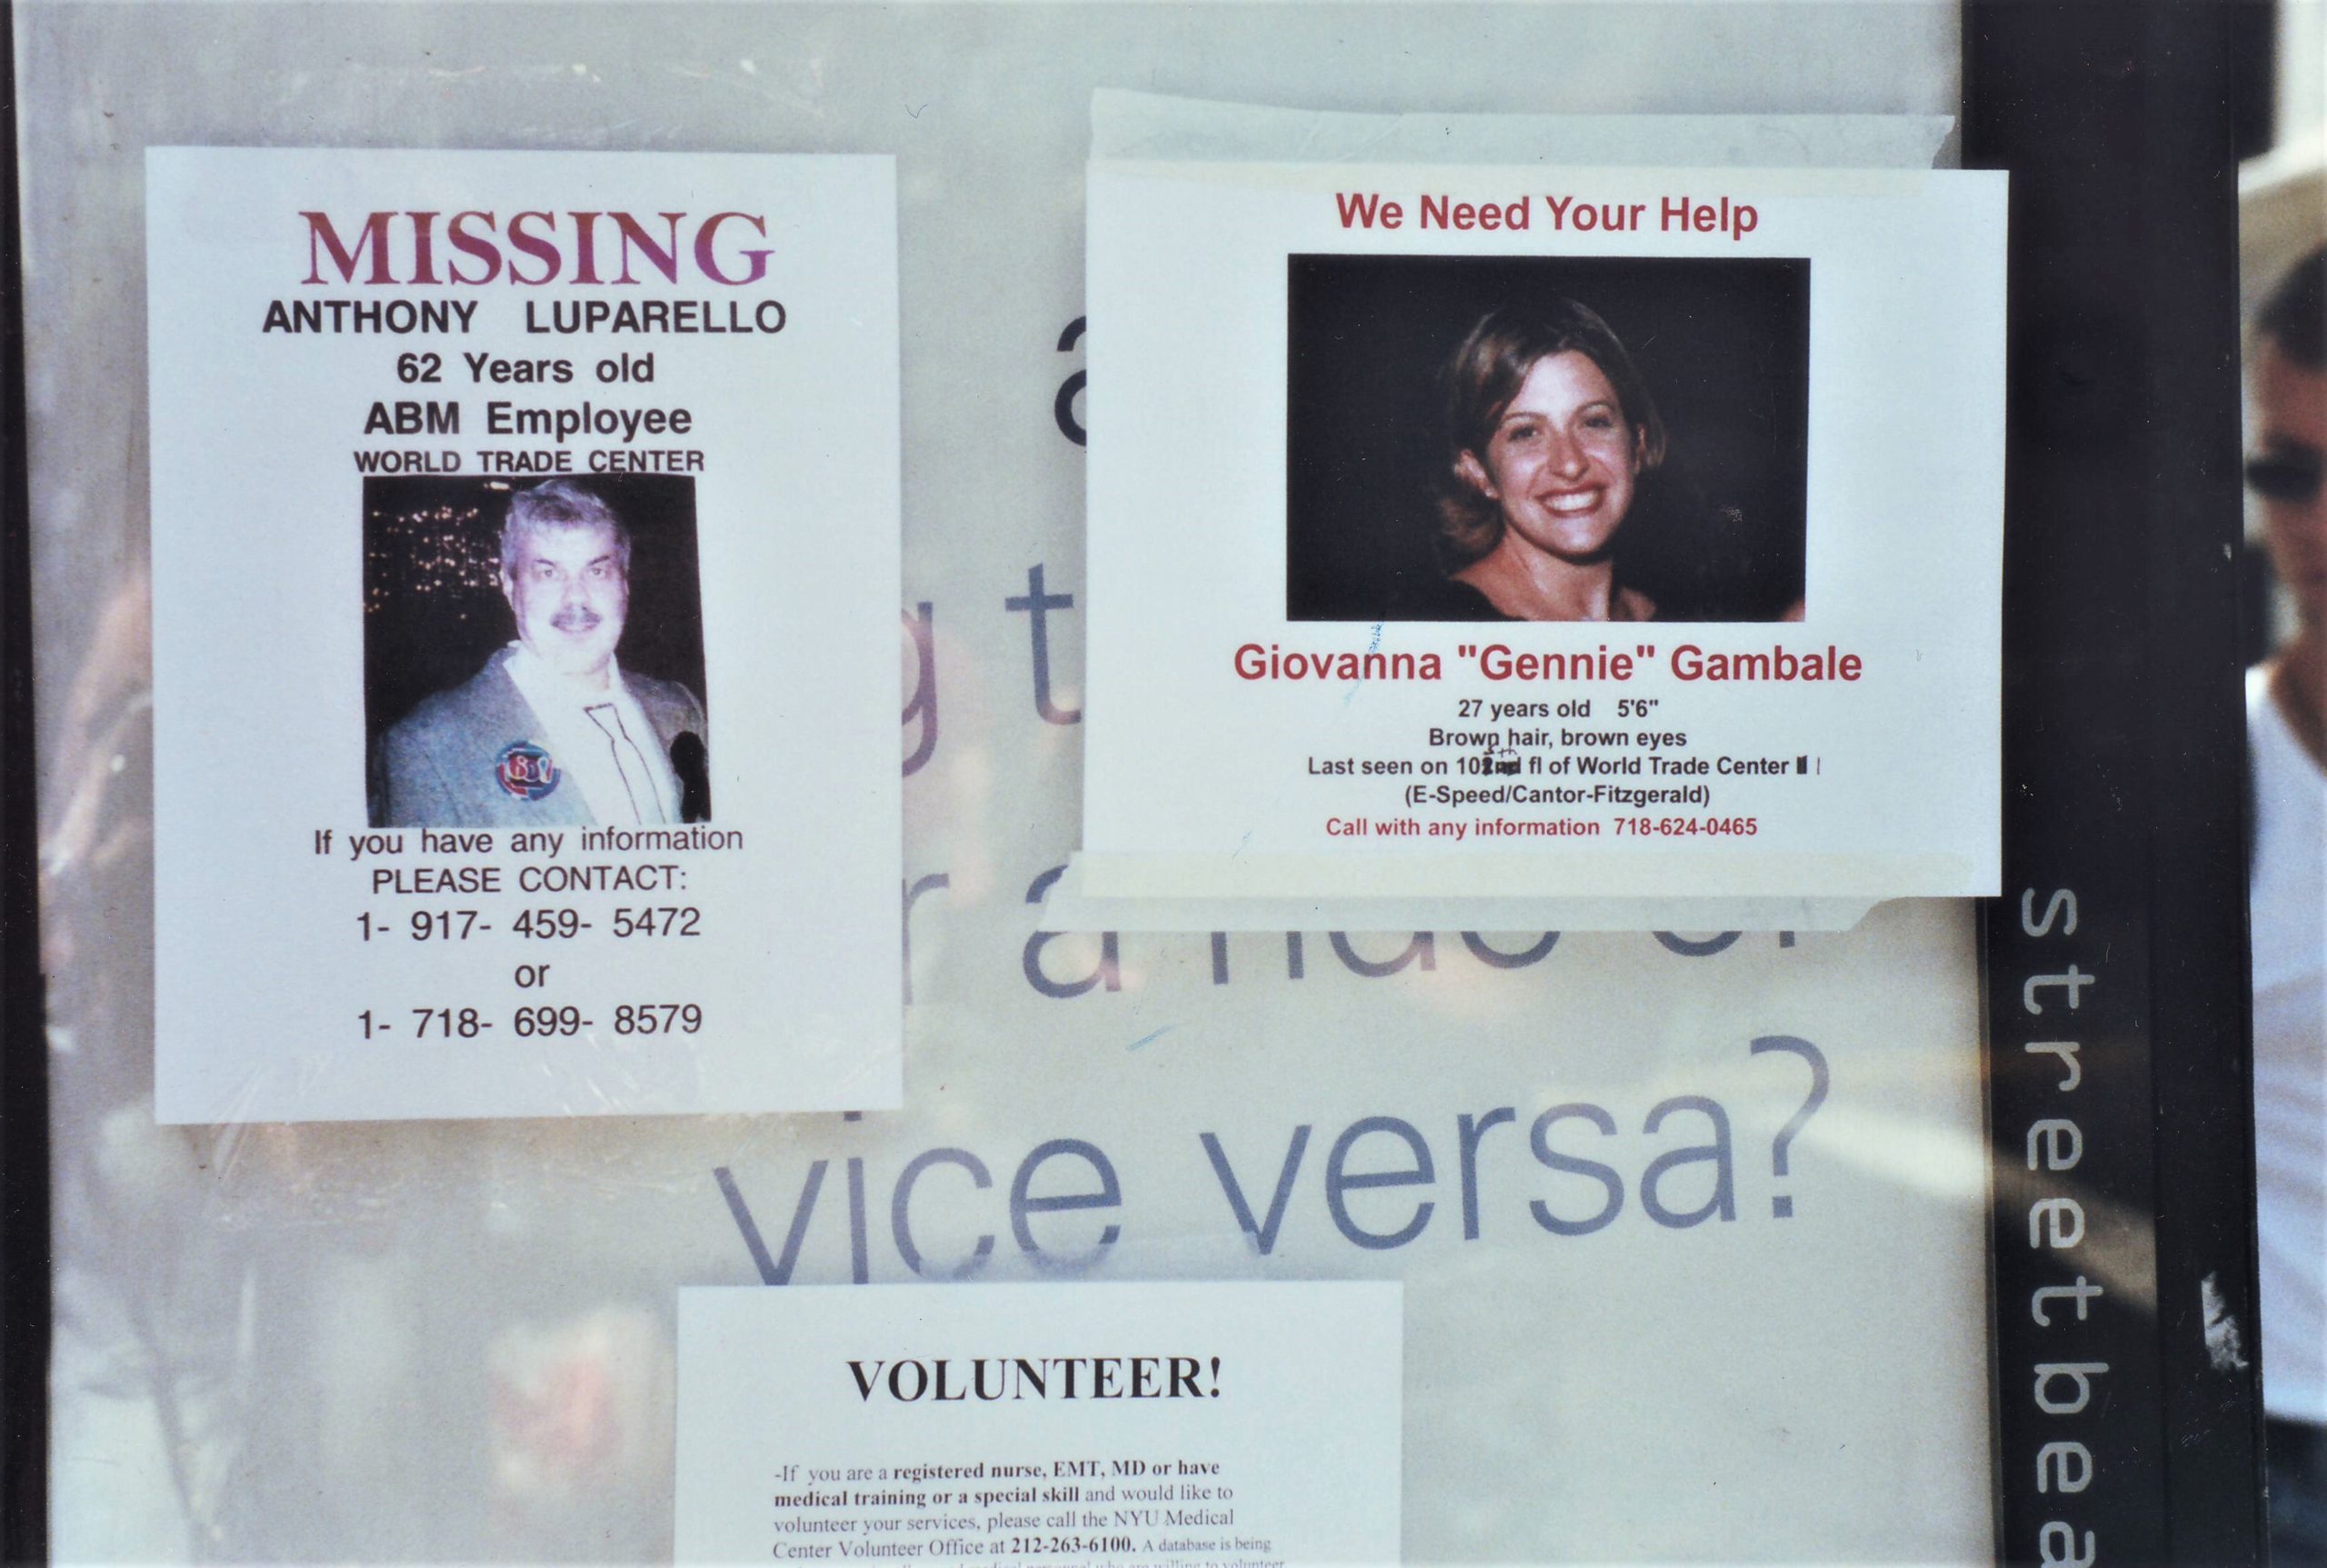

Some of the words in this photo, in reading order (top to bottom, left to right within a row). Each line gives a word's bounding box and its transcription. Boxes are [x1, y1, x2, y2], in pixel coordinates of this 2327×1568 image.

[1335, 192, 1403, 230] We
[1420, 194, 1530, 231] Need
[1545, 195, 1647, 232] Your
[1661, 196, 1759, 242] Help
[298, 211, 774, 286] MISSING
[262, 299, 478, 335] ANTHONY
[525, 299, 787, 335] LUPARELLO
[396, 352, 442, 384] 62
[463, 352, 574, 384] Years
[595, 352, 654, 384] old
[363, 401, 460, 435] ABM
[486, 401, 693, 444] Employee
[353, 450, 462, 476] WORLD
[476, 450, 574, 476] TRADE
[588, 449, 704, 474] CENTER
[1233, 642, 1442, 681] Giovanna
[1458, 644, 1655, 682] "Gennie"
[1671, 644, 1863, 682] Gambale
[1458, 698, 1483, 718] 27
[1490, 703, 1550, 723] years
[1556, 699, 1591, 718] old
[1617, 699, 1659, 718] 5'6"
[1429, 727, 1500, 747] Brown
[1506, 727, 1553, 752] hair,
[1561, 727, 1630, 747] brown
[1636, 732, 1688, 752] eyes
[1308, 756, 1355, 775] Last
[1361, 760, 1413, 775] seen
[1420, 761, 1448, 775] on
[1528, 755, 1543, 774] fl
[1548, 755, 1572, 775] of
[1576, 756, 1642, 775] World
[1648, 755, 1710, 775] Trade
[1716, 755, 1790, 775] Center
[1404, 784, 1711, 809] (E-Speed/Cantor-Fitzgerald)
[315, 829, 333, 855] If
[348, 834, 404, 862] you
[421, 827, 494, 854] have
[510, 832, 564, 859] any
[581, 824, 743, 852] information
[1325, 817, 1367, 836] Call
[1374, 817, 1421, 836] with
[1428, 822, 1468, 842] any
[1475, 817, 1600, 836] information
[1613, 817, 1758, 836] 718-624-0465
[373, 866, 502, 894] PLEASE
[518, 864, 686, 893] CONTACT:
[411, 910, 492, 942] 917-
[512, 908, 593, 940] 459-
[613, 906, 701, 938] 5472
[514, 964, 551, 989] or
[412, 1007, 493, 1039] 718-
[514, 1005, 594, 1038] 699-
[614, 1003, 703, 1035] 8579
[713, 1109, 1124, 1285] vice
[1198, 1034, 1830, 1257] versa?
[2020, 887, 2111, 1568] streetbea
[847, 1356, 1221, 1403] VOLUNTEER!
[807, 1469, 841, 1486] you
[846, 1468, 874, 1482] are
[878, 1468, 887, 1481] a
[894, 1462, 984, 1483] registered
[991, 1465, 1047, 1478] nurse,
[1054, 1461, 1105, 1477] EMT,
[1112, 1460, 1146, 1476] MD
[1152, 1463, 1172, 1476] or
[1178, 1459, 1220, 1475] have
[774, 1490, 847, 1507] medical
[854, 1489, 926, 1509] training
[932, 1493, 953, 1504] or
[958, 1493, 968, 1504] a
[974, 1486, 1036, 1508] special
[1042, 1486, 1079, 1503] skill
[1084, 1485, 1115, 1503] and
[1121, 1484, 1174, 1502] would
[1180, 1483, 1212, 1501] like
[1217, 1486, 1233, 1500] to
[774, 1515, 857, 1533] volunteer
[863, 1519, 903, 1536] your
[906, 1513, 981, 1531] services,
[987, 1512, 1041, 1533] please
[1046, 1510, 1076, 1528] call
[1082, 1510, 1108, 1528] the
[1114, 1510, 1158, 1527] NYU
[1164, 1508, 1233, 1526] Medical
[773, 1543, 833, 1559] Center
[838, 1540, 924, 1558] Volunteer
[928, 1538, 984, 1556] Office
[989, 1540, 1004, 1554] at
[1012, 1536, 1136, 1553] 212-263-6100.
[1143, 1539, 1154, 1553] A
[1158, 1537, 1216, 1553] database
[1220, 1536, 1232, 1551] is
[1234, 1536, 1272, 1553] being
